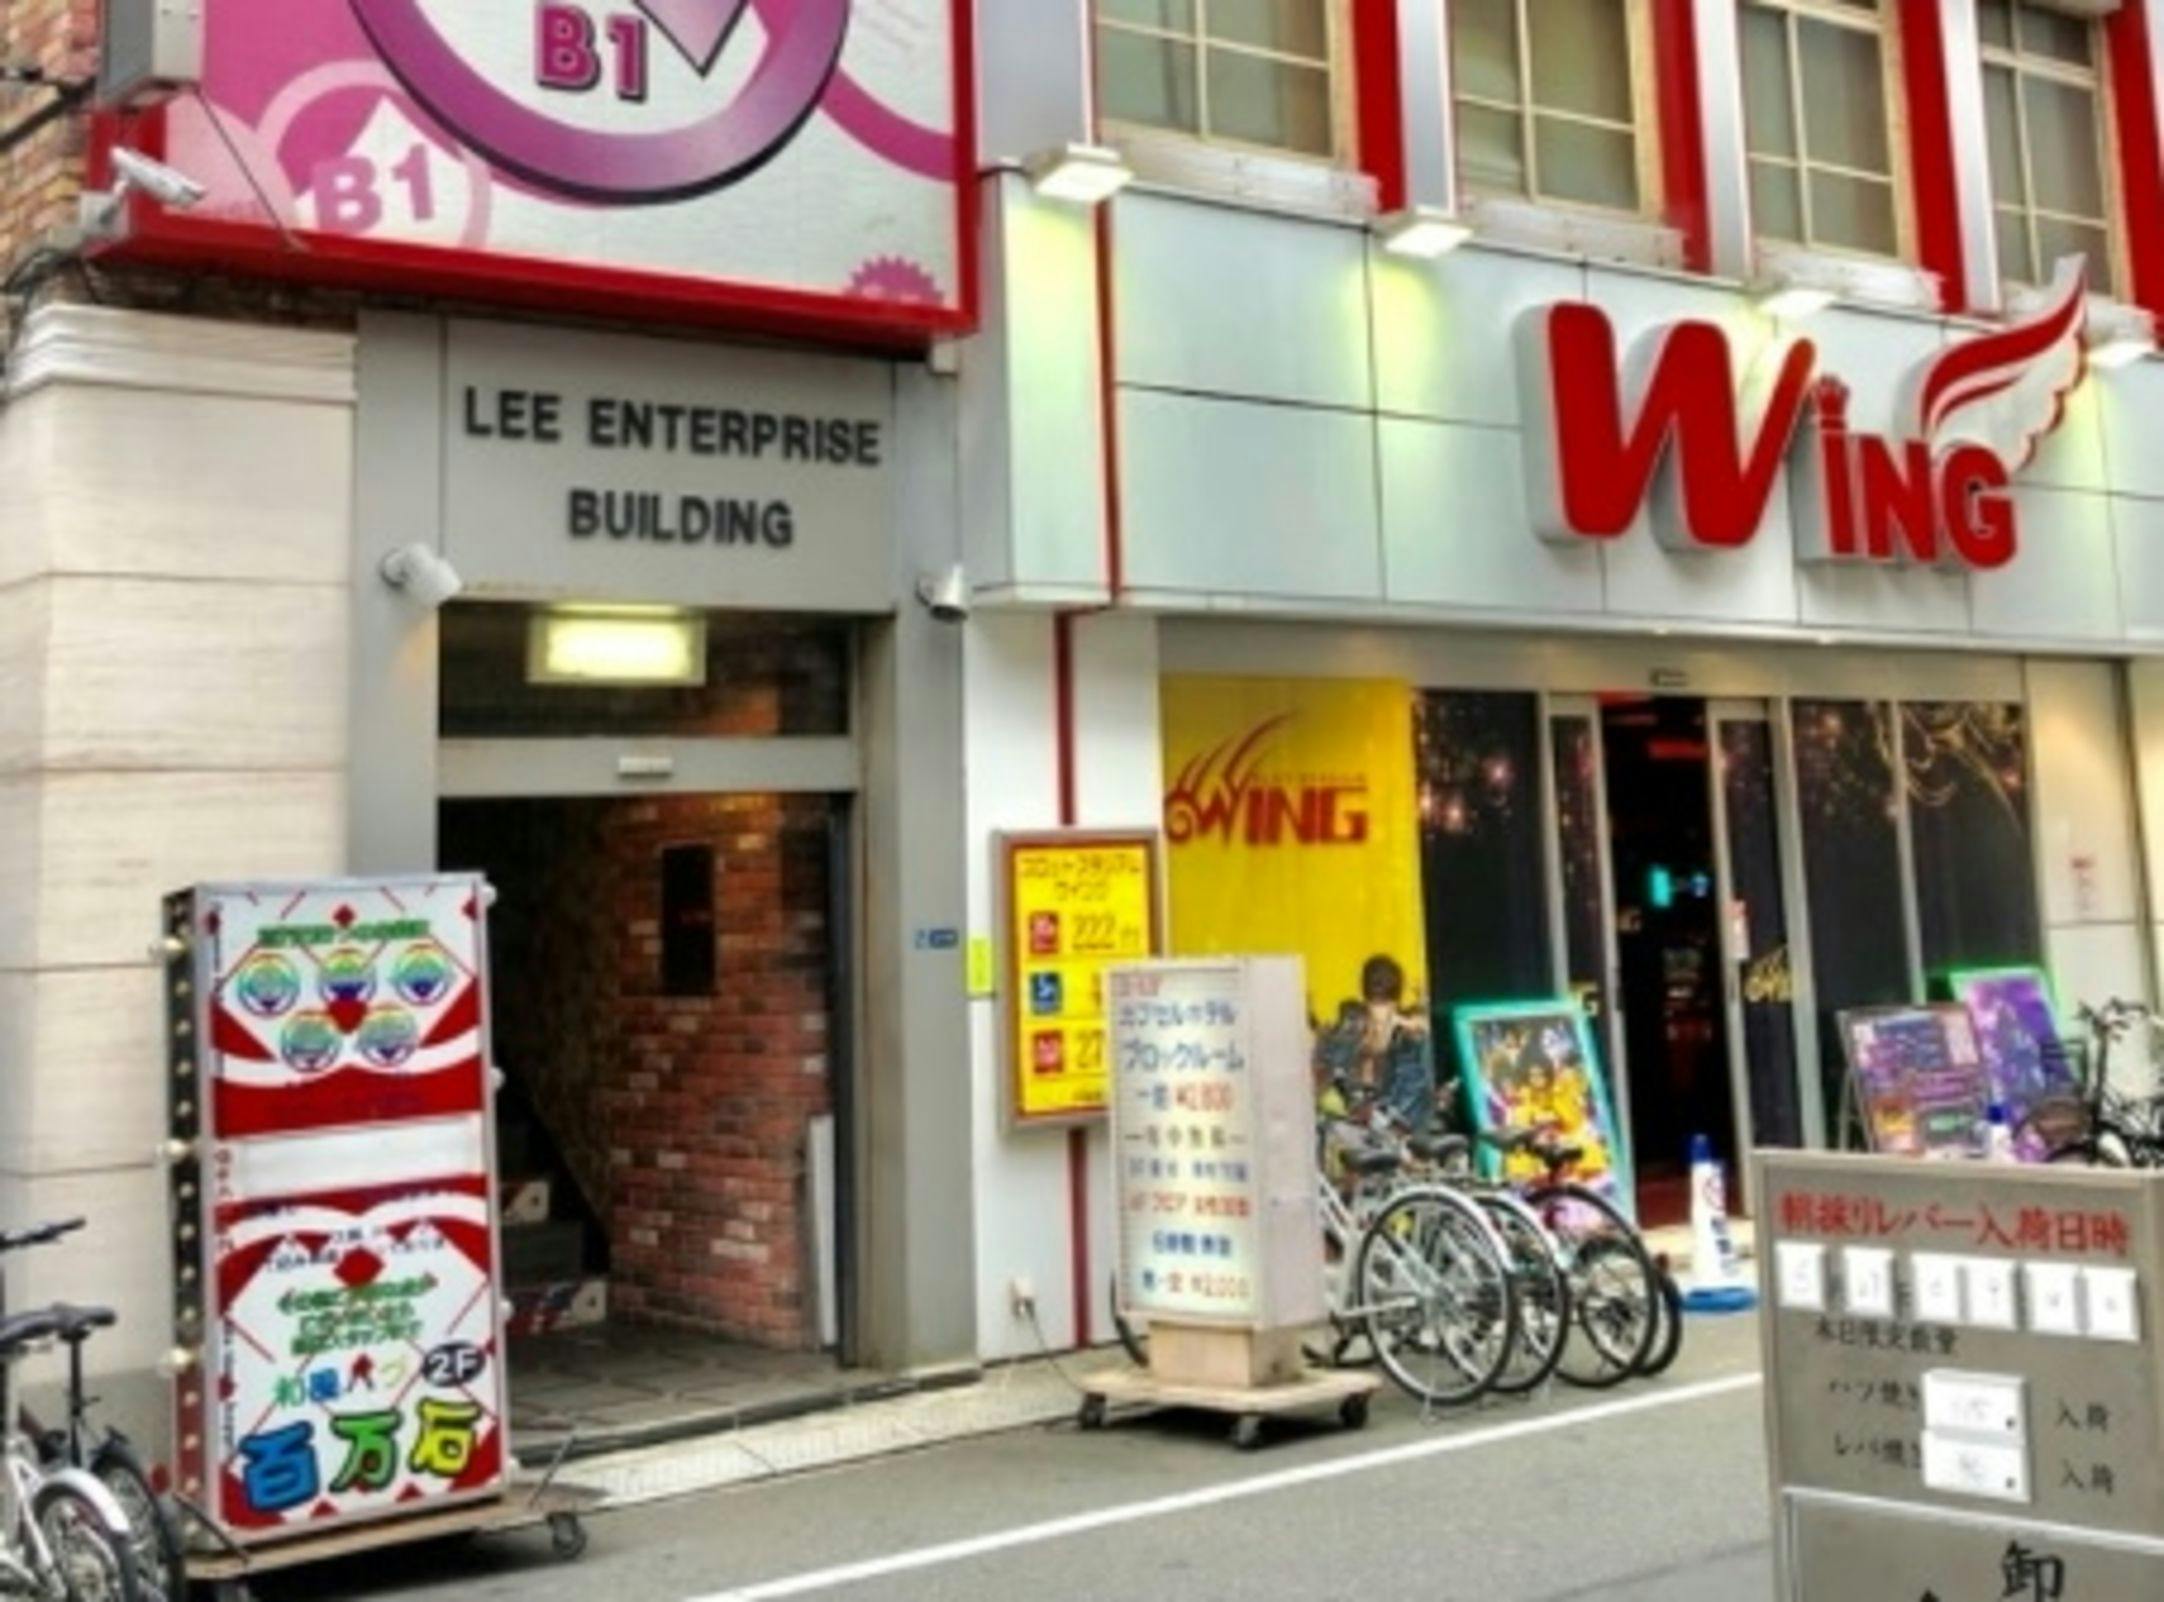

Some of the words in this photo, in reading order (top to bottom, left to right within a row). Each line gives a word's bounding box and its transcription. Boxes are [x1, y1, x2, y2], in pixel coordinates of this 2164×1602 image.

[535, 6, 650, 101] B1
[312, 144, 437, 233] B1
[464, 386, 562, 443] LEE
[588, 398, 881, 466] ENTERPRISE
[568, 490, 794, 548] BUILDING
[425, 1352, 481, 1378] 2F
[238, 1396, 484, 1511] 百万石
